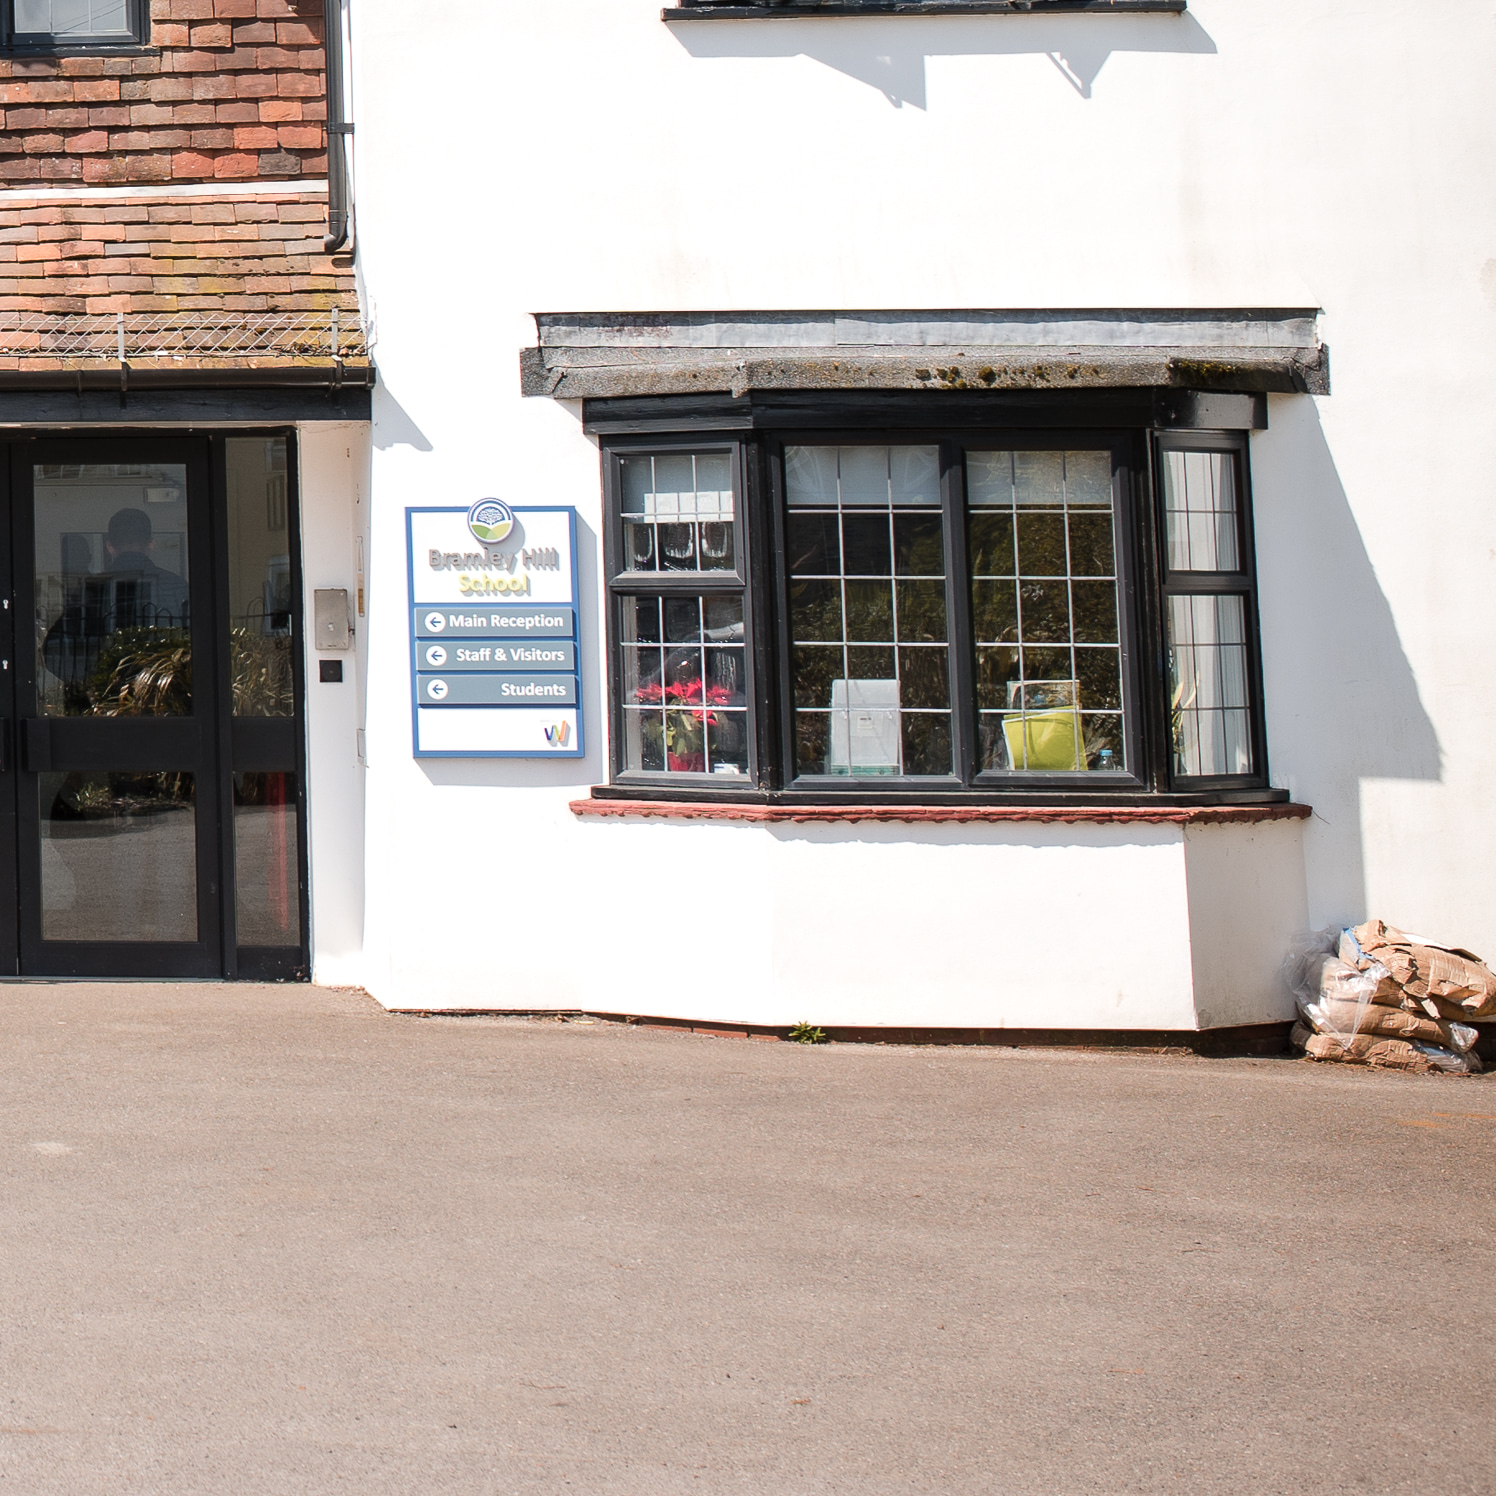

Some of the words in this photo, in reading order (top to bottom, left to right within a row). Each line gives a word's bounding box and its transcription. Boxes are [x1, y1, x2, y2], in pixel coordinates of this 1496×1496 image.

[428, 547, 516, 571] Bramley
[521, 547, 557, 567] Hill
[458, 573, 528, 593] School
[448, 614, 487, 628] Main
[491, 614, 564, 630] Reception
[456, 647, 492, 662] Staff
[494, 648, 507, 662] &
[510, 647, 565, 662] Visitors
[501, 682, 567, 697] Students
